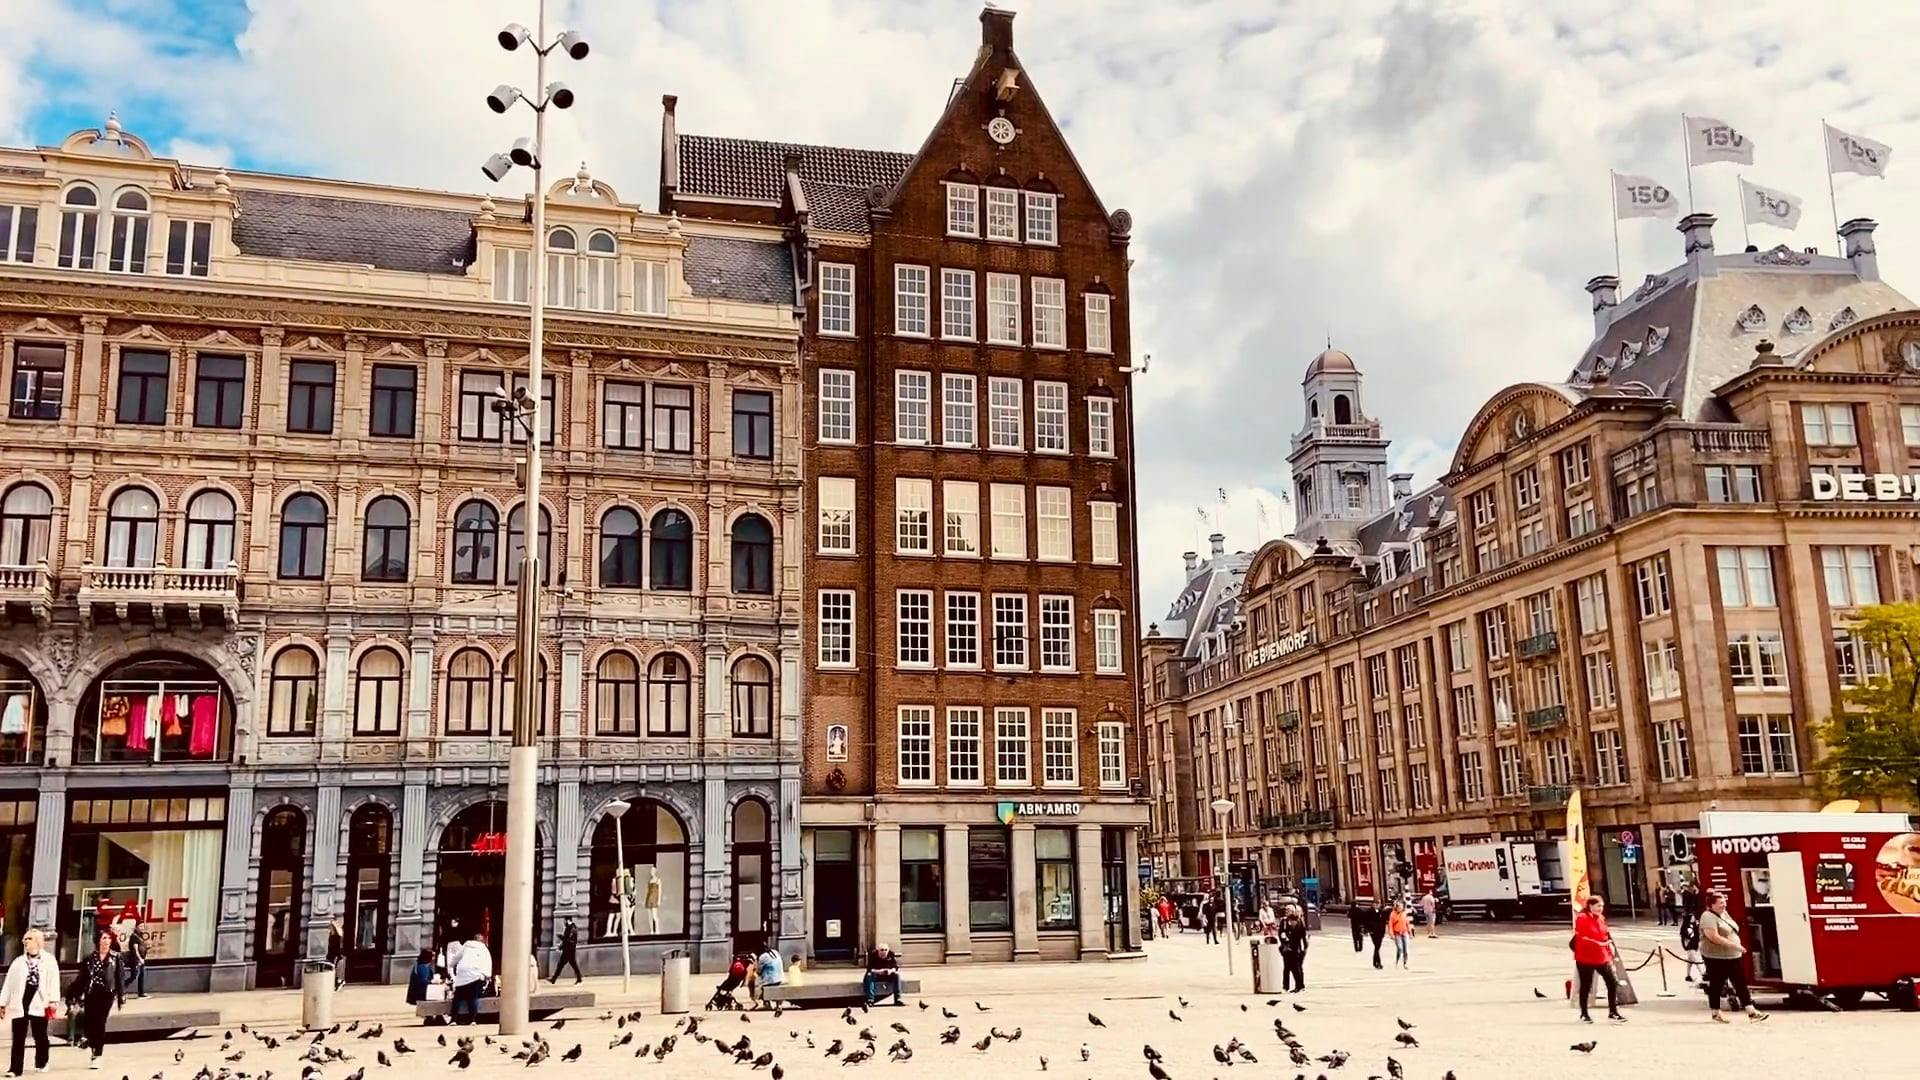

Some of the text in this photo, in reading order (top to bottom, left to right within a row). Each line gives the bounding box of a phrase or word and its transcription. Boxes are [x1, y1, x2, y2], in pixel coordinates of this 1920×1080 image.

[1626, 185, 1670, 204] 150
[1811, 472, 1869, 500] DE
[1247, 629, 1309, 669] DE BIJENKORF
[1711, 835, 1780, 854] HOTDOGS
[97, 896, 189, 924] SALE
